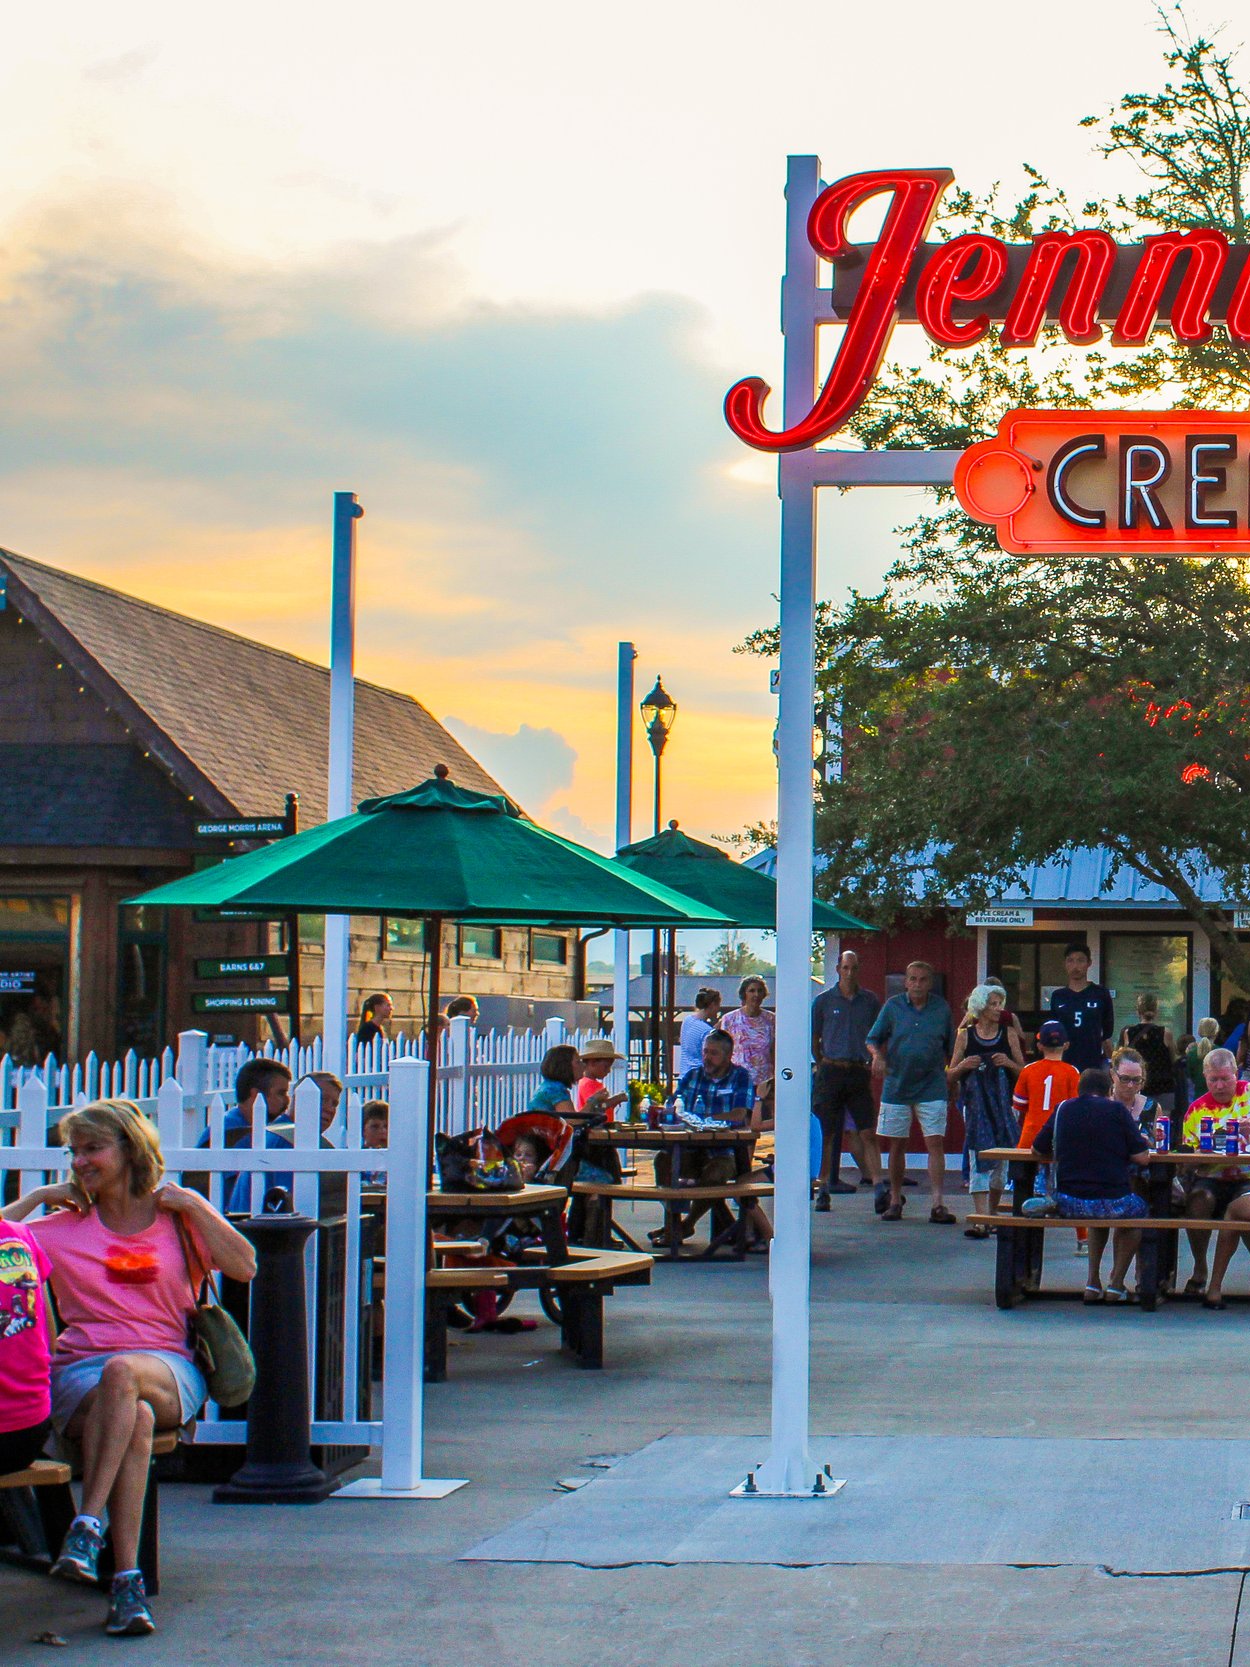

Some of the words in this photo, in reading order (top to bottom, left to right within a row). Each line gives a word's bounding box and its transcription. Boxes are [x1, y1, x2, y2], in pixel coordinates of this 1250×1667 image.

[198, 825, 228, 833] GEORGE
[229, 824, 256, 832] MORRIS
[258, 823, 283, 831] ARENA
[220, 963, 247, 972] BARNS
[205, 998, 242, 1007] SHOPPING
[1074, 1011, 1083, 1027] 5
[1043, 1075, 1053, 1111] 1
